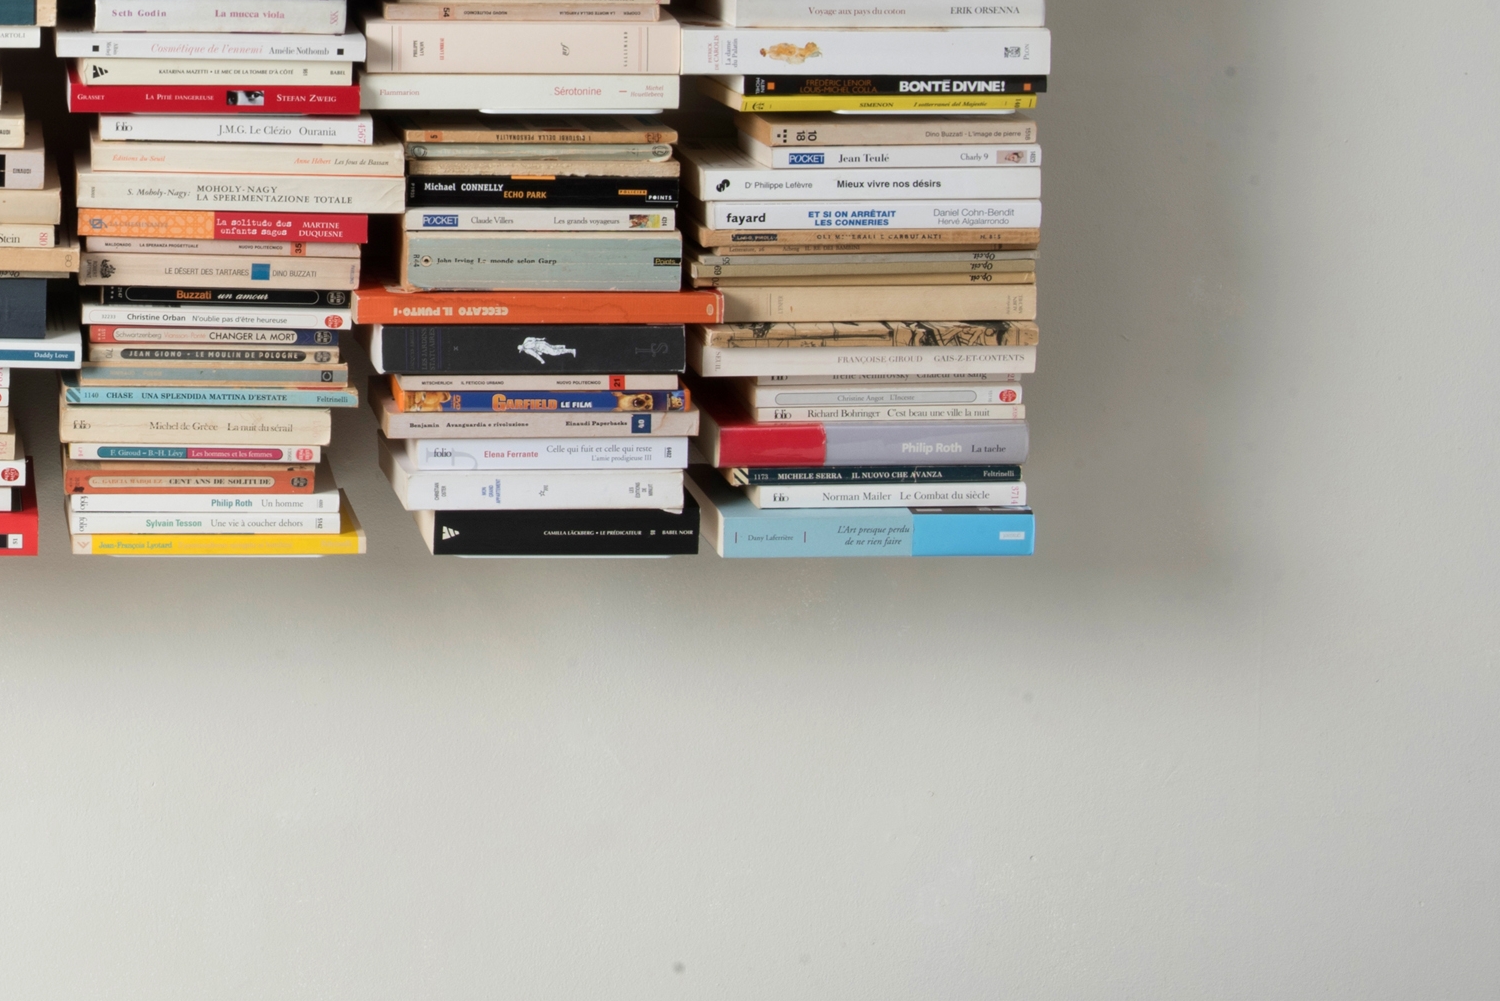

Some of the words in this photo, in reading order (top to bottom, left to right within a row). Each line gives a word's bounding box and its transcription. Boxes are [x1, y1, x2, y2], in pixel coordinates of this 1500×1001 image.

[554, 86, 602, 96] Sérotonine
[899, 79, 950, 93] BONTÉ
[952, 81, 1006, 92] DIVINE!
[424, 182, 456, 191] Michael
[461, 183, 504, 193] CONNELLY
[837, 179, 865, 189] Mieux
[867, 179, 890, 188] vivre
[912, 179, 942, 188] désirs
[504, 190, 524, 199] ECHO
[526, 191, 547, 199] PARK
[933, 208, 962, 217] Daniel
[965, 208, 1015, 217] Cohn-Bendit
[726, 212, 766, 225] fayard
[176, 290, 212, 300] Buzzati
[209, 332, 253, 341] CHANGER
[256, 332, 267, 341] LA
[270, 332, 296, 341] MORT
[492, 393, 558, 411] GARFIELD
[574, 401, 593, 409] FILM
[902, 442, 933, 455] Philip
[936, 442, 962, 453] Roth
[971, 444, 980, 453] La
[982, 444, 1006, 453] tache
[484, 450, 505, 459] Elena
[507, 450, 539, 459] Ferrante
[211, 499, 233, 509] Philip
[235, 499, 253, 508] Roth
